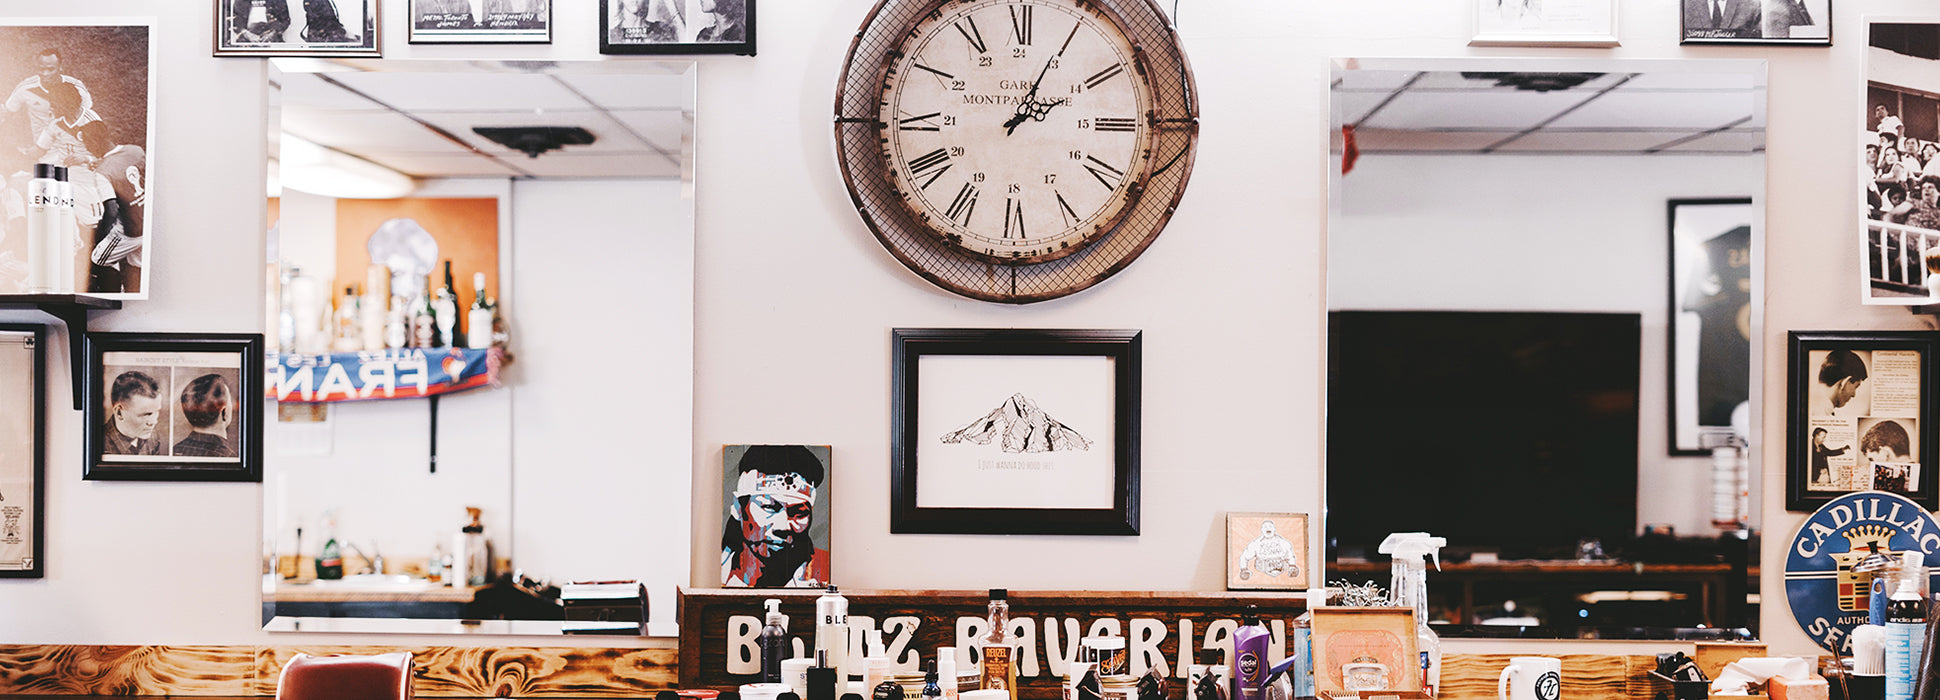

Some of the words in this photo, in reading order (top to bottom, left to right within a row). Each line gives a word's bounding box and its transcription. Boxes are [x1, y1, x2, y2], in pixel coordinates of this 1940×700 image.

[1012, 47, 1027, 58] 24
[977, 56, 993, 67] 23
[951, 80, 966, 91] 22
[1069, 84, 1083, 94] 14
[943, 115, 957, 126] 21
[1077, 118, 1090, 129] 15
[950, 146, 965, 157] 20
[1068, 150, 1082, 160] 16
[972, 172, 986, 183] 19
[1044, 173, 1057, 184] 17
[1007, 183, 1021, 194] 18
[29, 195, 59, 205] END
[1797, 498, 1940, 559] CADILLAC
[726, 614, 921, 676] BTZ
